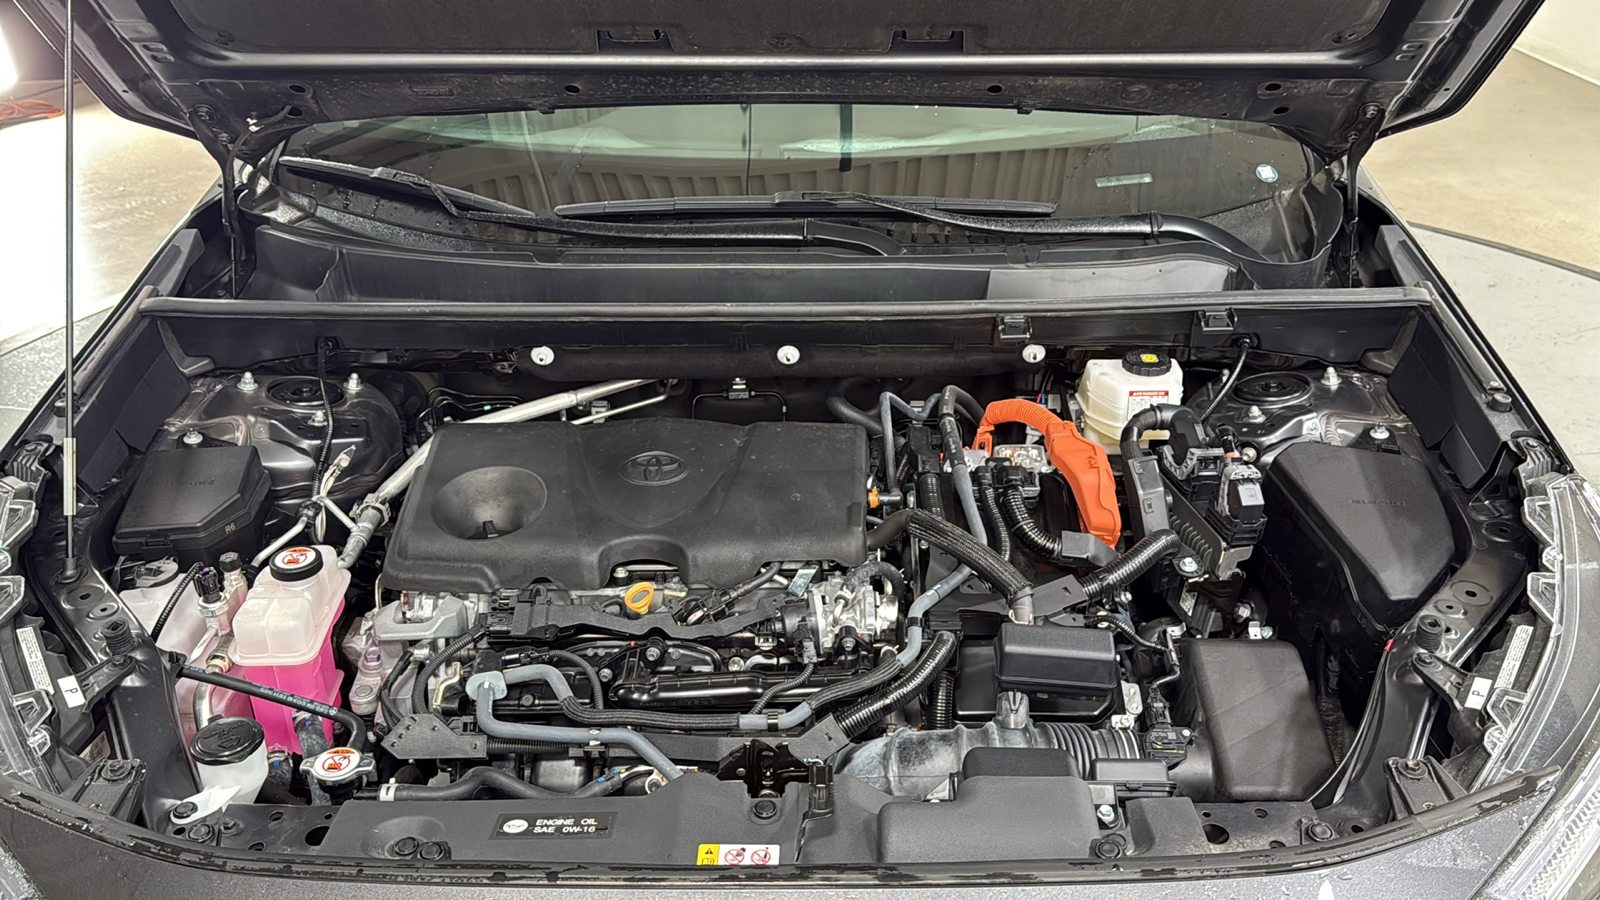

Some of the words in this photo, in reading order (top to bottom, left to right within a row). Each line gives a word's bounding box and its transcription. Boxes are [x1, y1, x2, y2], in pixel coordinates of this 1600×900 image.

[224, 522, 236, 534] R6
[1471, 690, 1485, 698] P
[535, 818, 575, 826] ENGINE
[580, 818, 598, 826] OIL
[533, 826, 556, 834] SAE
